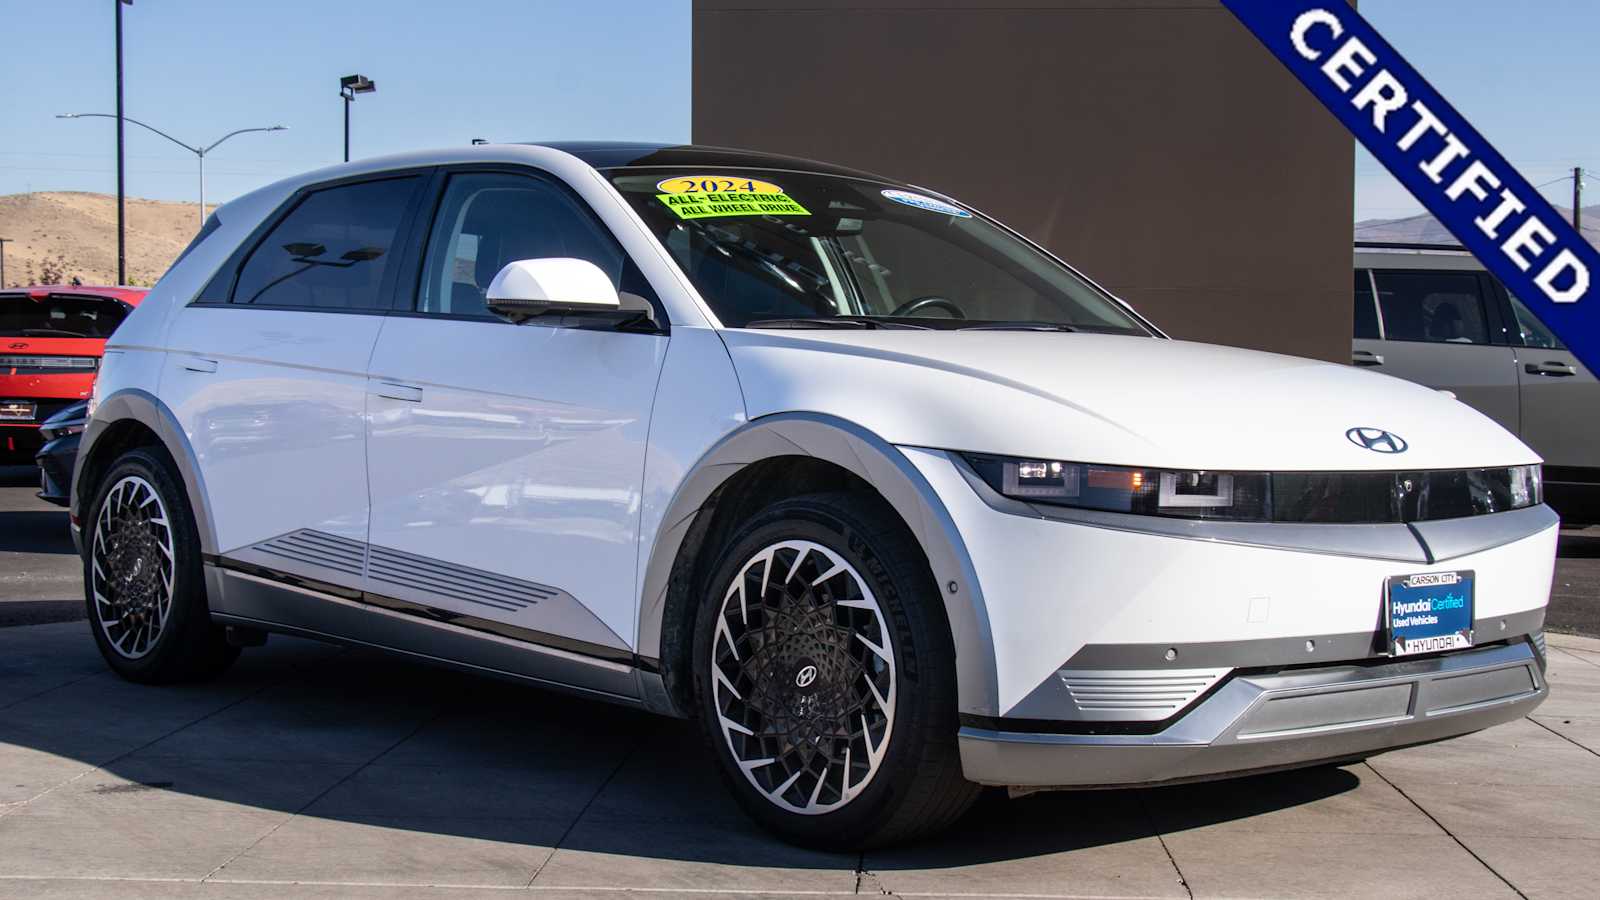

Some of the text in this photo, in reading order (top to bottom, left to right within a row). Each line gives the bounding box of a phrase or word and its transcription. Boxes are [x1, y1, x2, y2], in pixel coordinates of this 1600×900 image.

[679, 180, 757, 193] 2024
[681, 203, 800, 216] ALL WHEEL DRIVE
[1411, 573, 1455, 586] CARSON CITY
[1393, 594, 1464, 616] Hyundai Certified
[1393, 614, 1438, 628] Used Vehicles
[1412, 637, 1455, 652] HYUNDAI
